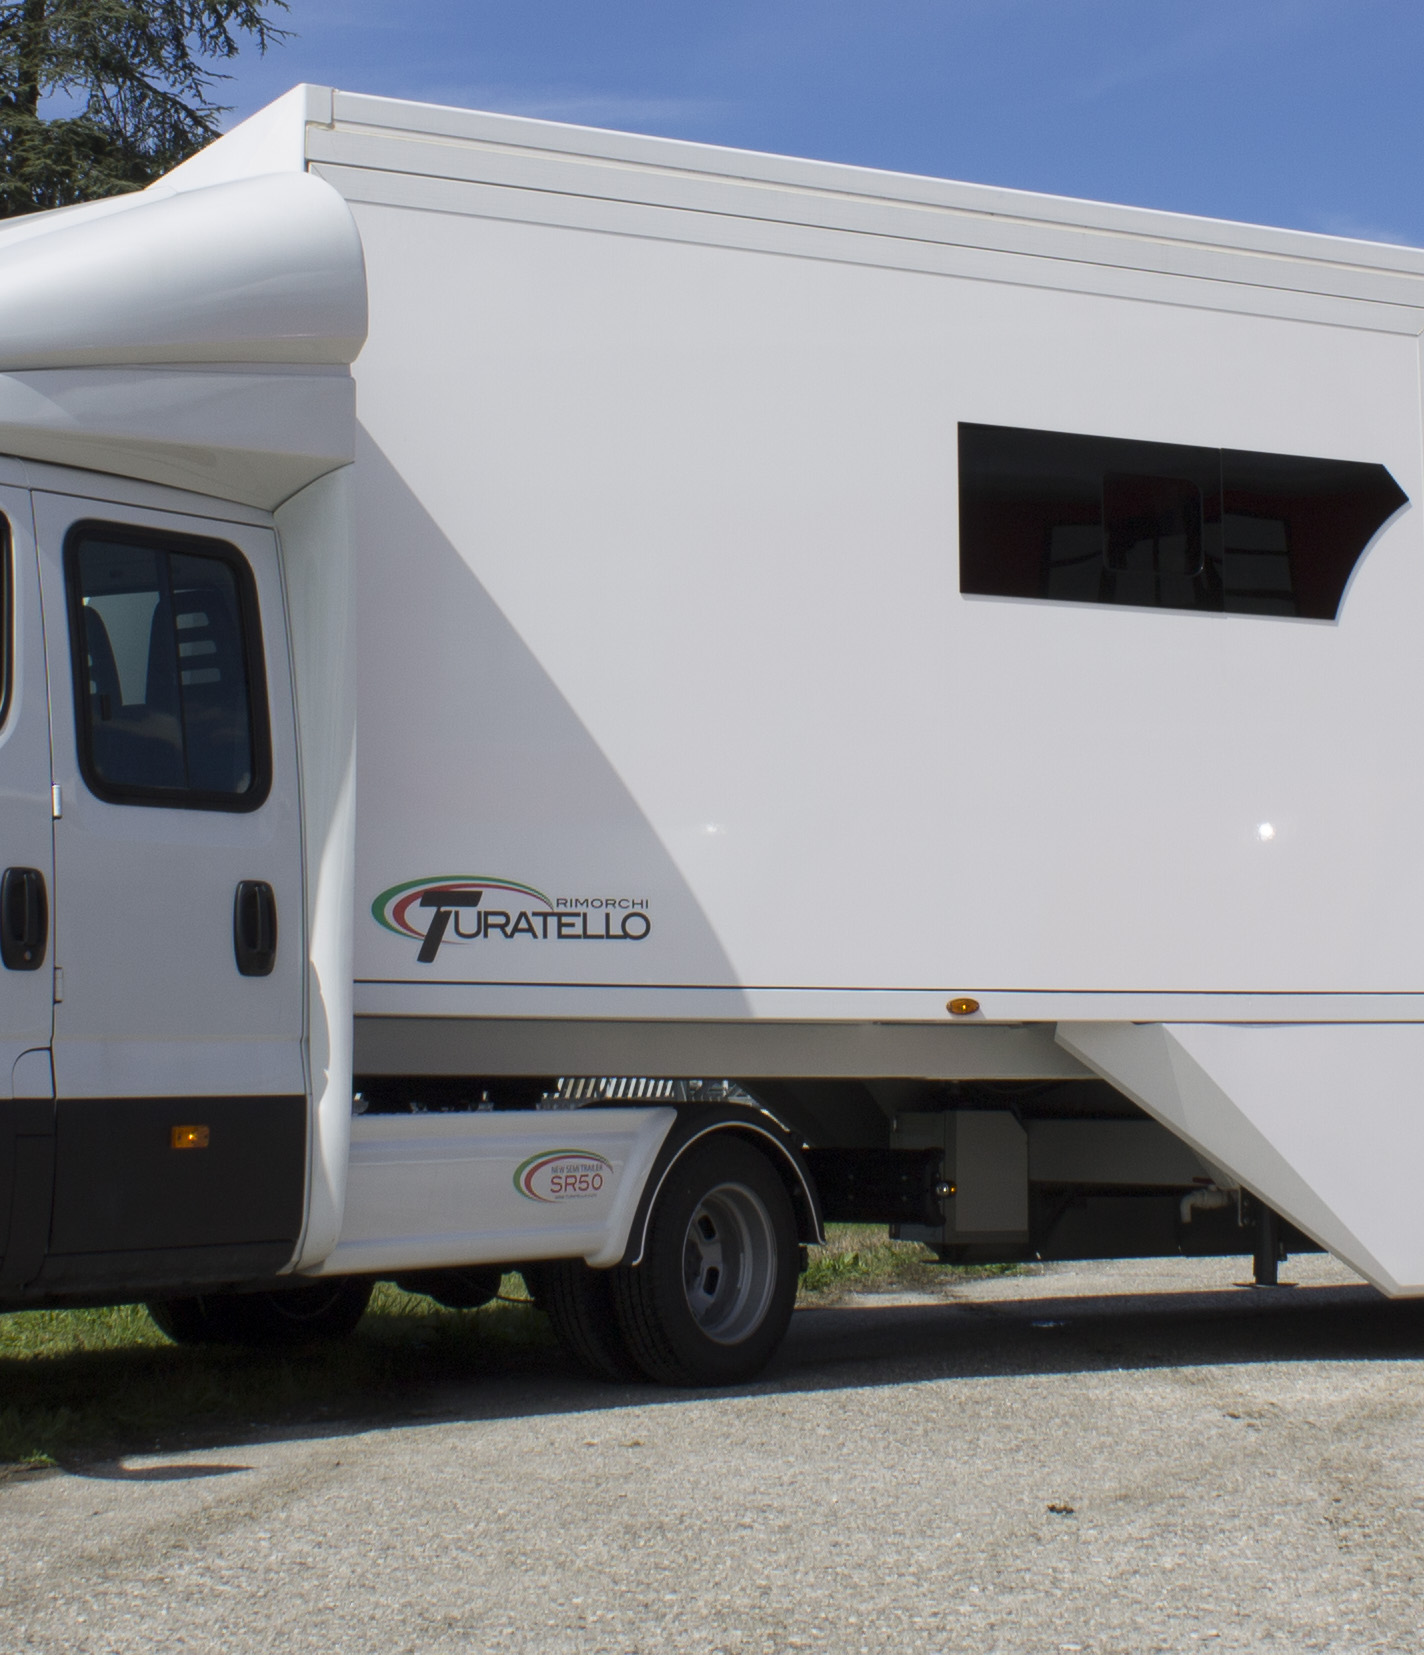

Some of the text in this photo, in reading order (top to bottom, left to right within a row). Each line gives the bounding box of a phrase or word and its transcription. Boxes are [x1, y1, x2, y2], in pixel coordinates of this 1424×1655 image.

[556, 897, 649, 910] RIMORCHI
[416, 890, 652, 964] TURATELLO
[550, 1173, 603, 1193] SR50
